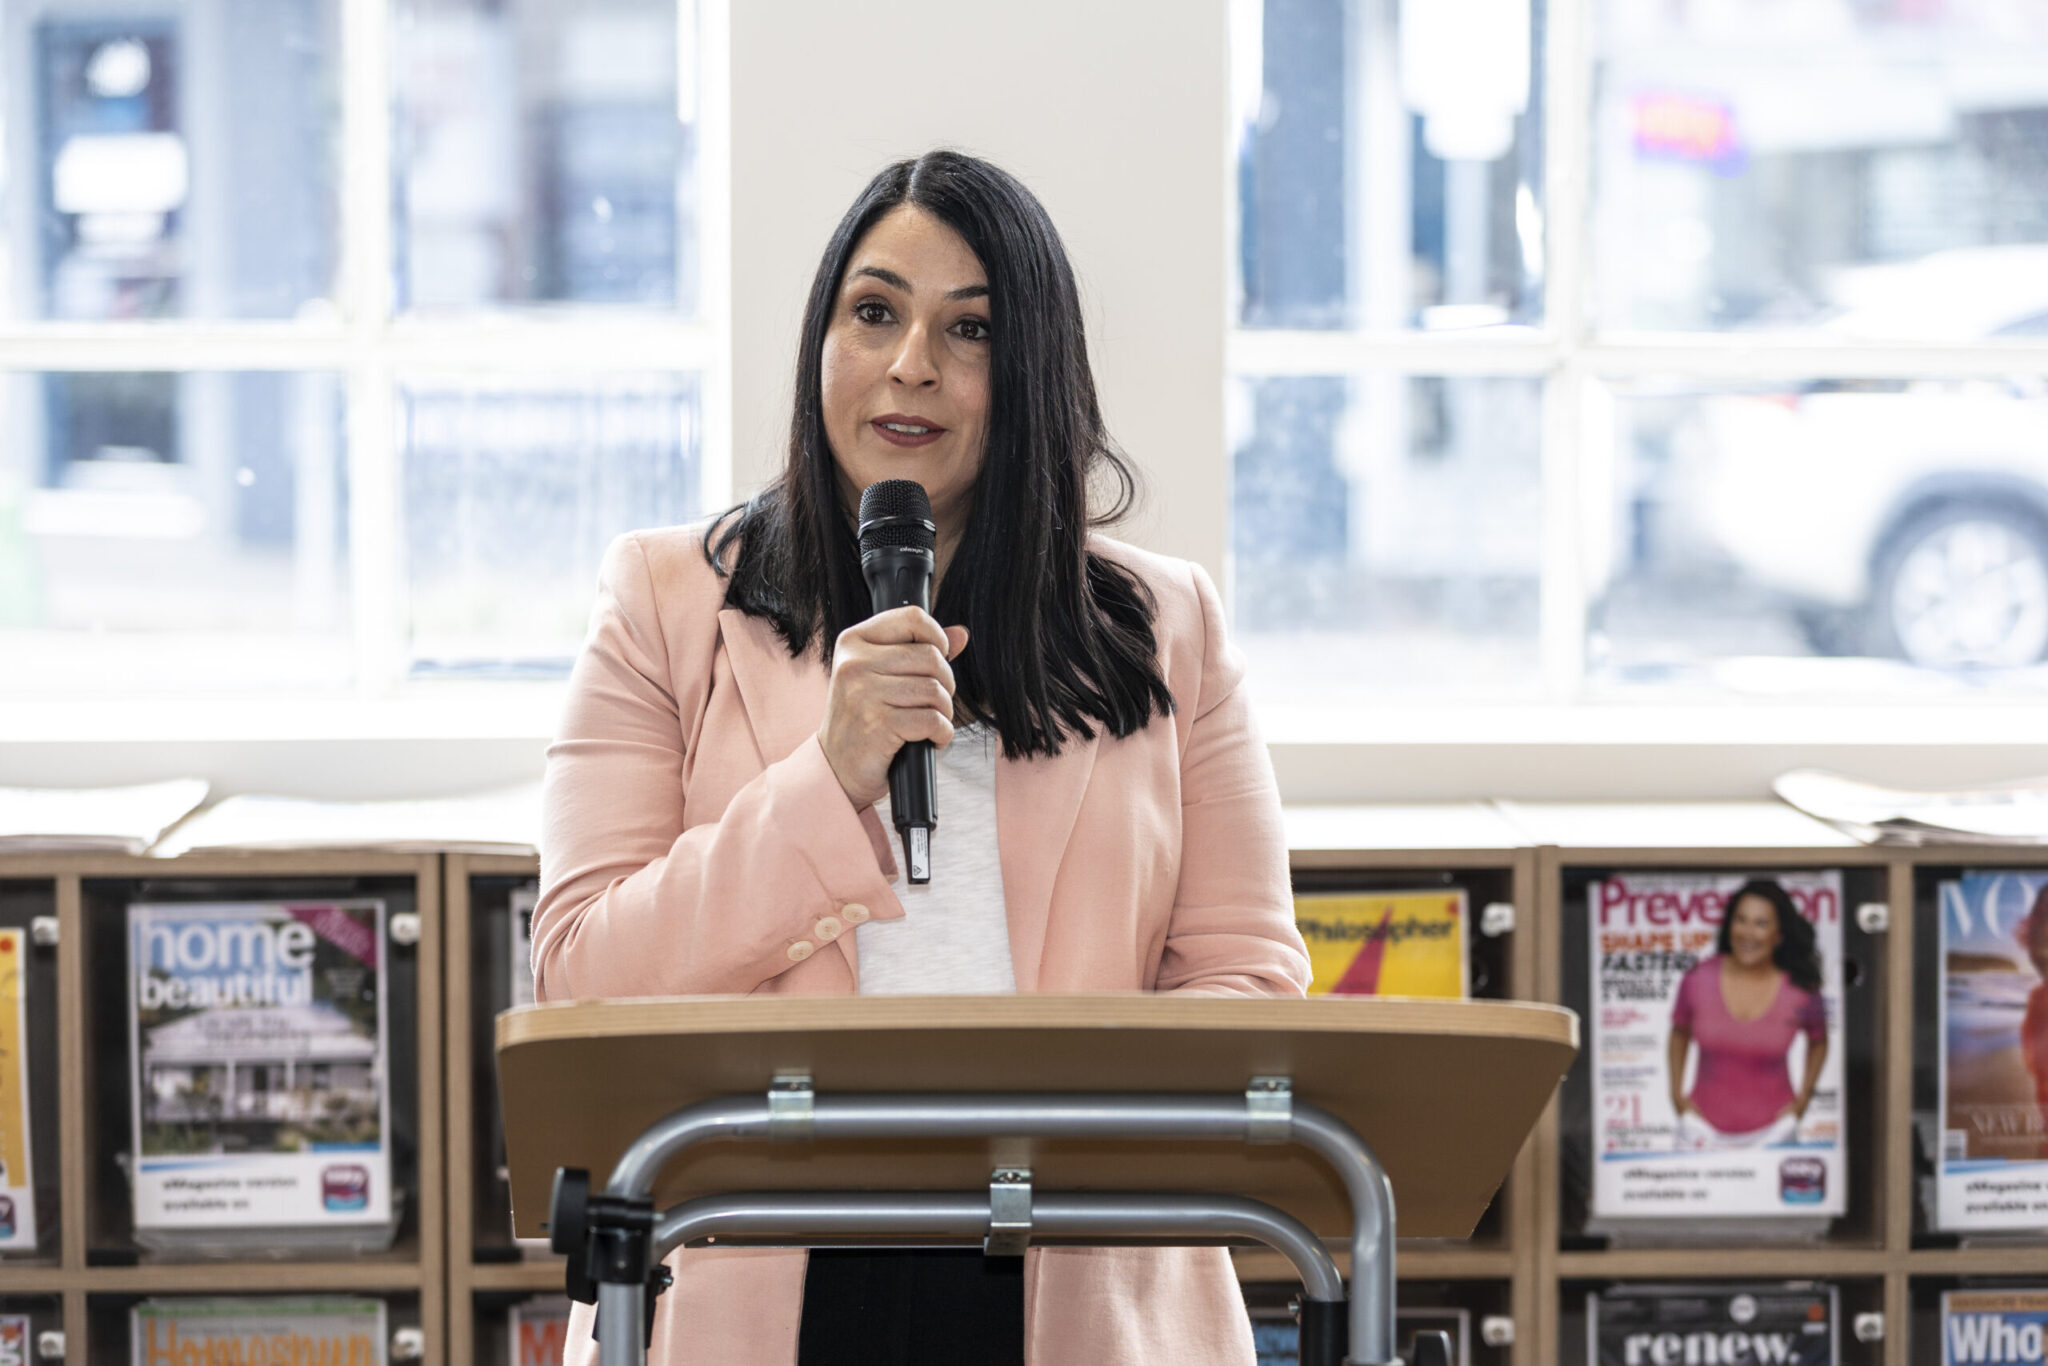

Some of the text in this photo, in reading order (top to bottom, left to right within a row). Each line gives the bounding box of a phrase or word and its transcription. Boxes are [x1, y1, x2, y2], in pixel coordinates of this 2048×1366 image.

[141, 915, 316, 971] home
[140, 966, 313, 1009] beautiful
[1950, 1314, 2043, 1363] Who
